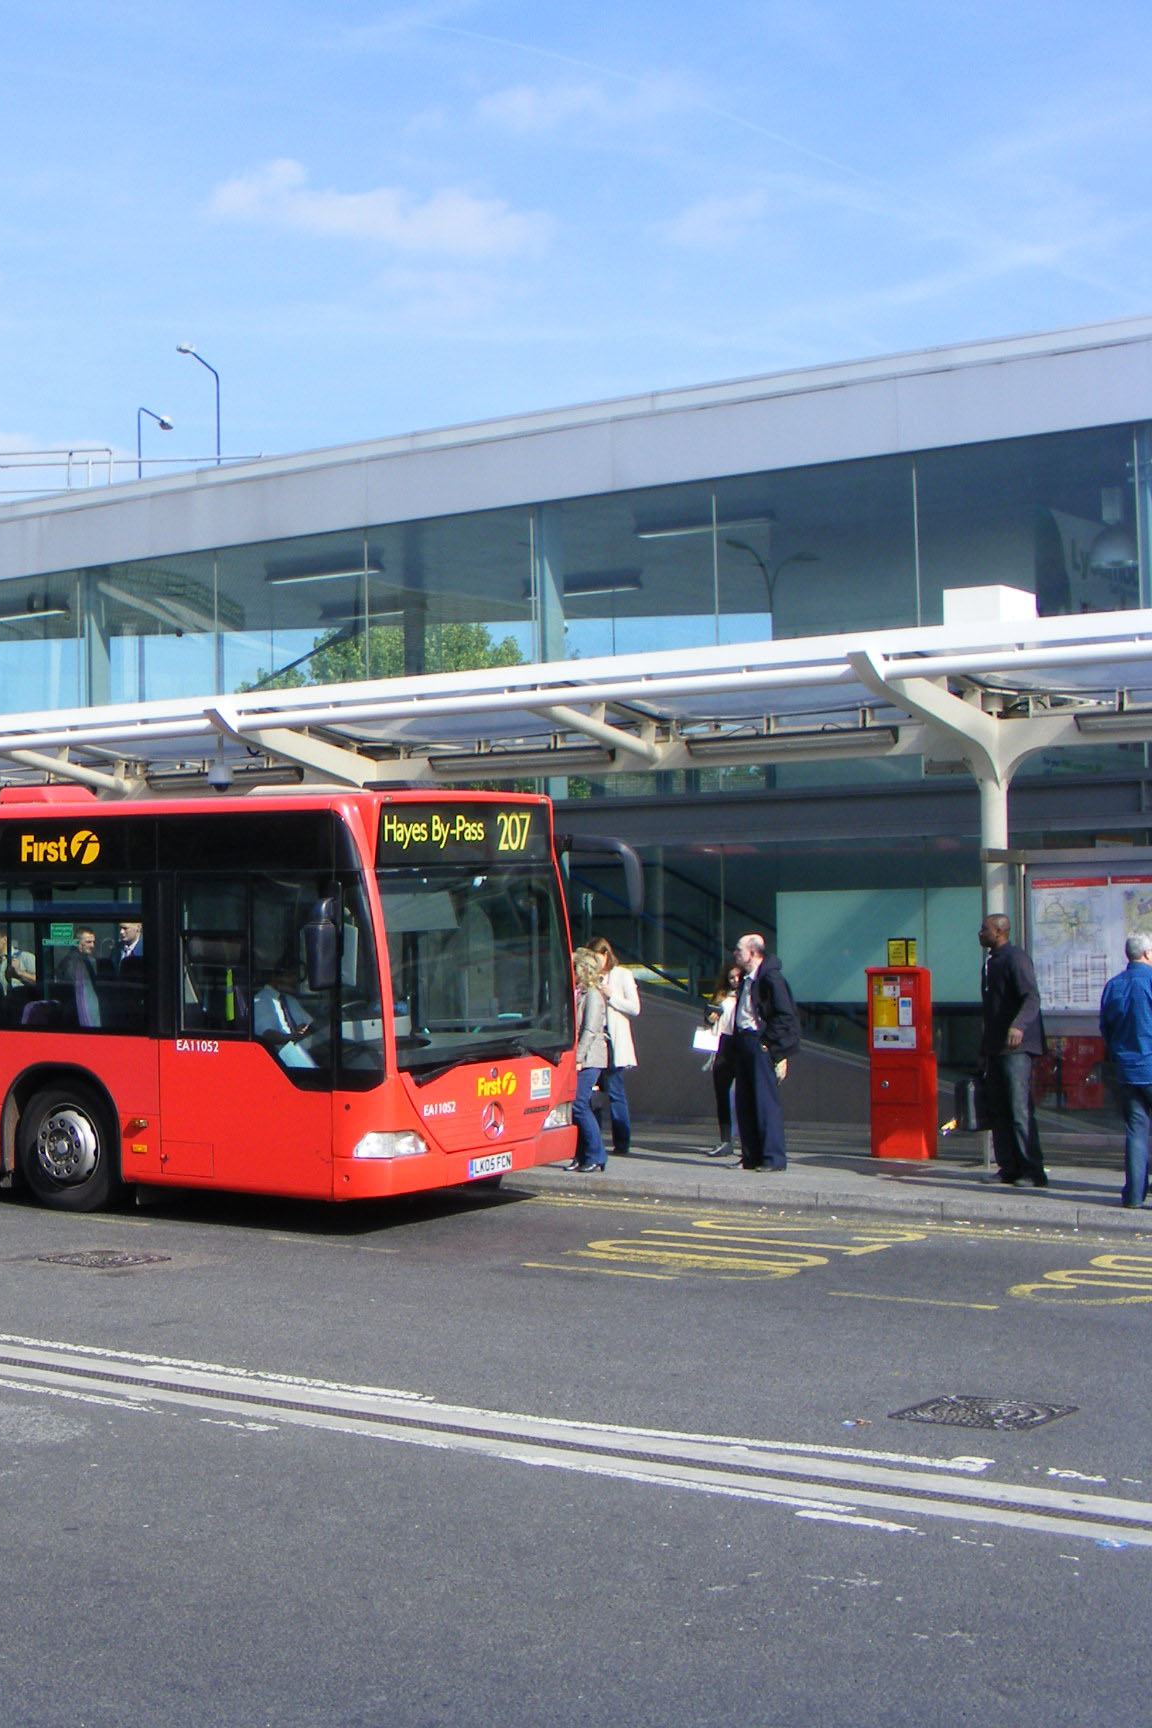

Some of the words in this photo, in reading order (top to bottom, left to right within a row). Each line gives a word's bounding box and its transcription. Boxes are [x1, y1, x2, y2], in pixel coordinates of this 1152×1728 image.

[384, 815, 427, 850] Hayes
[431, 814, 485, 850] By-Pass
[497, 812, 531, 851] 207
[21, 834, 68, 862] First
[176, 1039, 219, 1053] EA11052
[477, 1076, 502, 1097] First
[423, 1101, 456, 1117] EA11052
[474, 1156, 496, 1173] LK05
[497, 1154, 512, 1170] FCN
